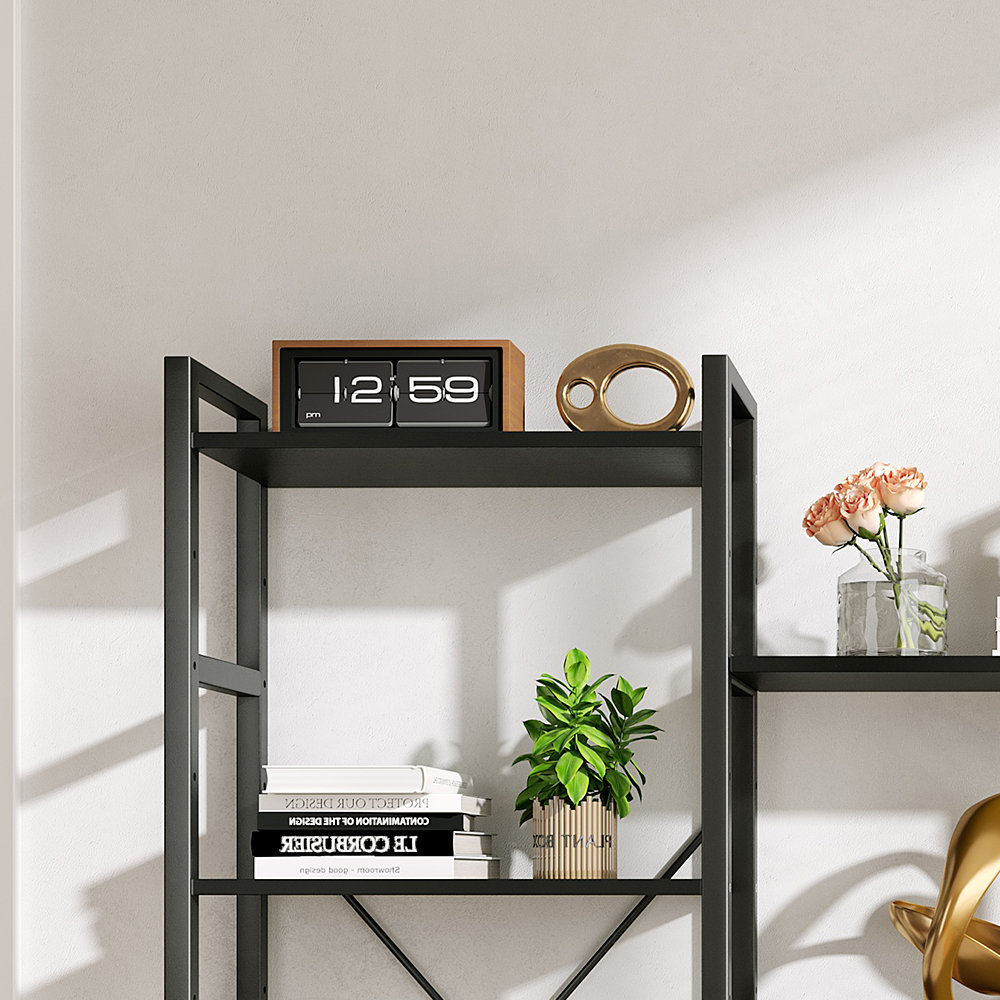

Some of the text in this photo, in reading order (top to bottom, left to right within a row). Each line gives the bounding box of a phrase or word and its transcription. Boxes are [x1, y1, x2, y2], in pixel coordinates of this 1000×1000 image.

[334, 376, 479, 404] 12 59
[306, 411, 321, 420] pm
